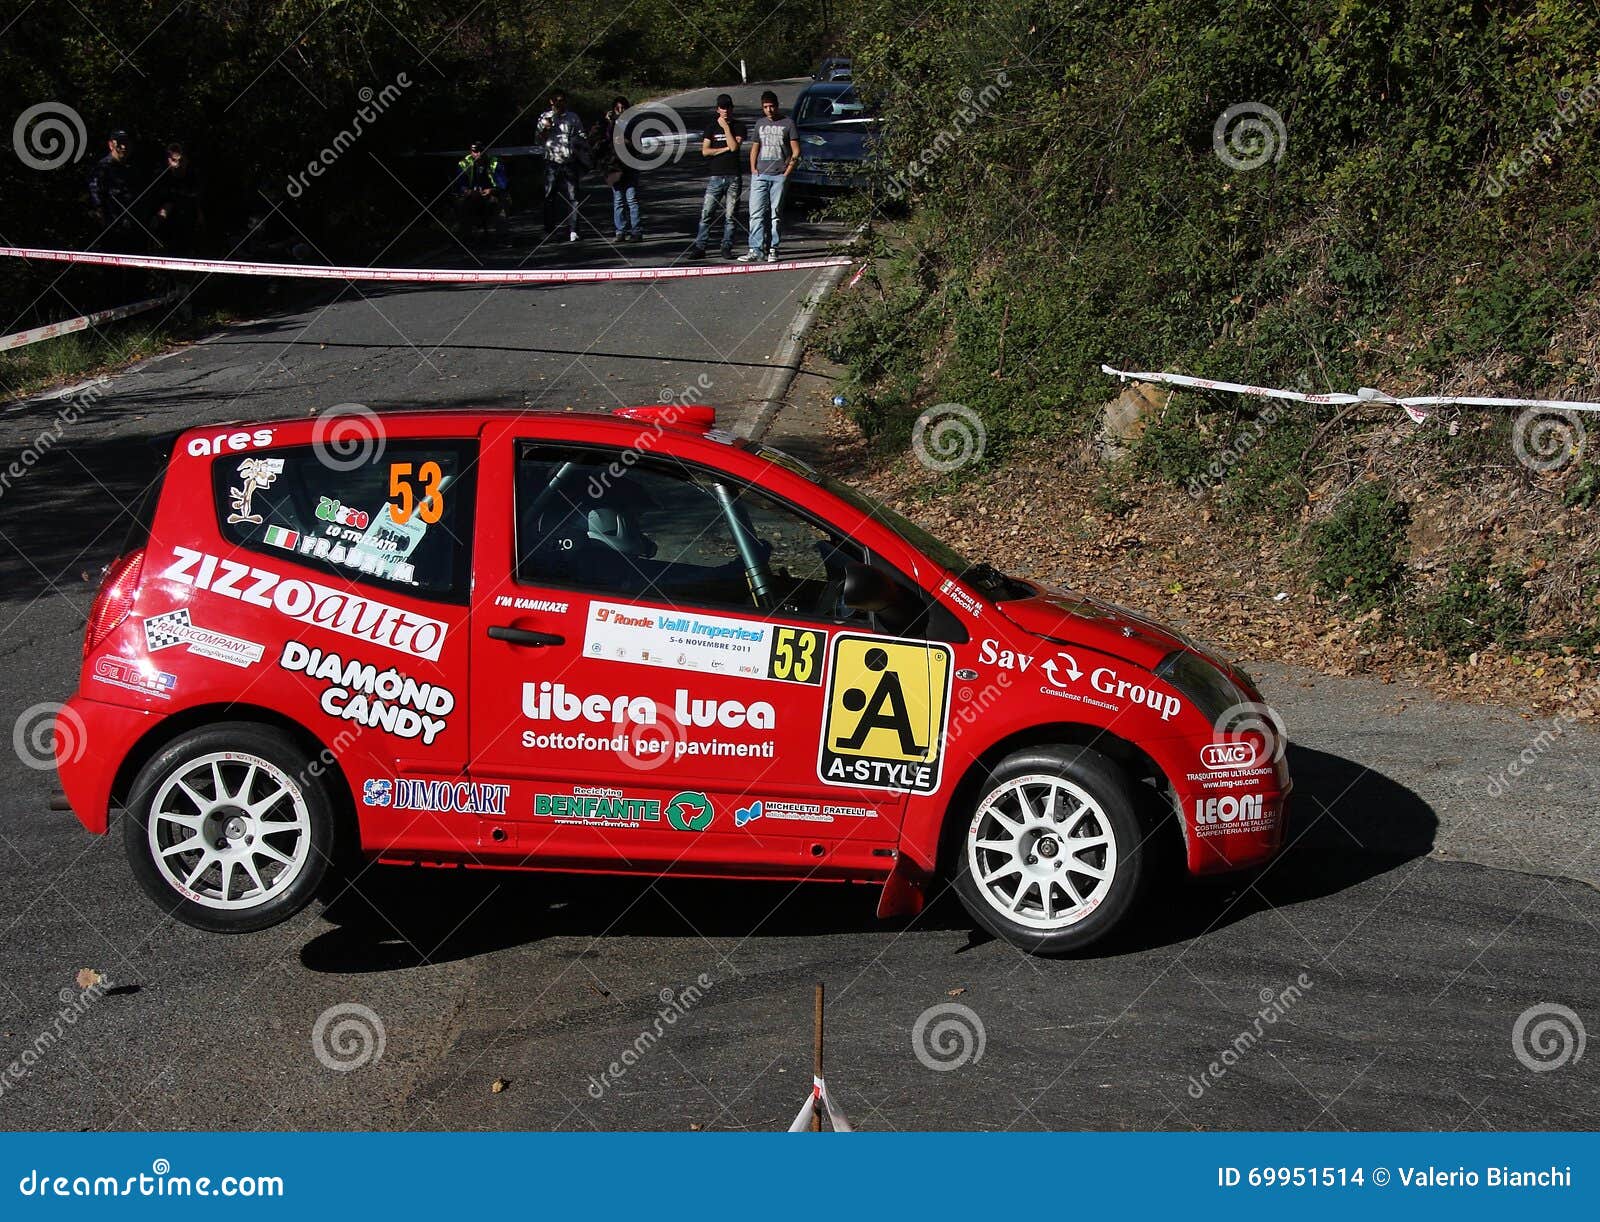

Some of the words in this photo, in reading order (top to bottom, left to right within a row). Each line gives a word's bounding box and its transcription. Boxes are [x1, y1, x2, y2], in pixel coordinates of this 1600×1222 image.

[187, 429, 274, 457] ares
[388, 461, 444, 525] 53
[325, 525, 342, 537] LO
[514, 597, 569, 613] KAMIKAZE
[613, 613, 654, 629] Ronde
[657, 616, 690, 633] Valli
[692, 622, 765, 643] Imperiesi
[669, 635, 684, 645] 5-6
[685, 638, 730, 650] NOVEMBRE
[732, 643, 751, 653] 2011
[773, 628, 817, 682] 53
[281, 640, 454, 717] DIAMOND
[977, 638, 1035, 673] Sav
[1089, 667, 1182, 721] Group
[521, 681, 658, 725] Libera
[674, 688, 776, 730] Luca
[1039, 686, 1081, 702] Consulenze
[1082, 695, 1120, 712] finanziarie
[320, 686, 446, 744] CANDY
[521, 730, 629, 753] Sottofondi
[635, 737, 670, 757] per
[674, 738, 775, 759] pavimenti
[1209, 746, 1246, 764] IMG
[827, 759, 932, 788] A-STYLE
[1186, 770, 1230, 781] TRASDUTTORI
[1202, 778, 1260, 789] www.img-us.com
[393, 779, 510, 815] DIMOCART
[534, 794, 662, 822] BENFANTE
[765, 801, 820, 814] MICHELETTI
[823, 805, 866, 817] FRATELLI
[1194, 822, 1240, 832] COSTRUZIONI
[1196, 828, 1242, 838] CARPENTERIA
